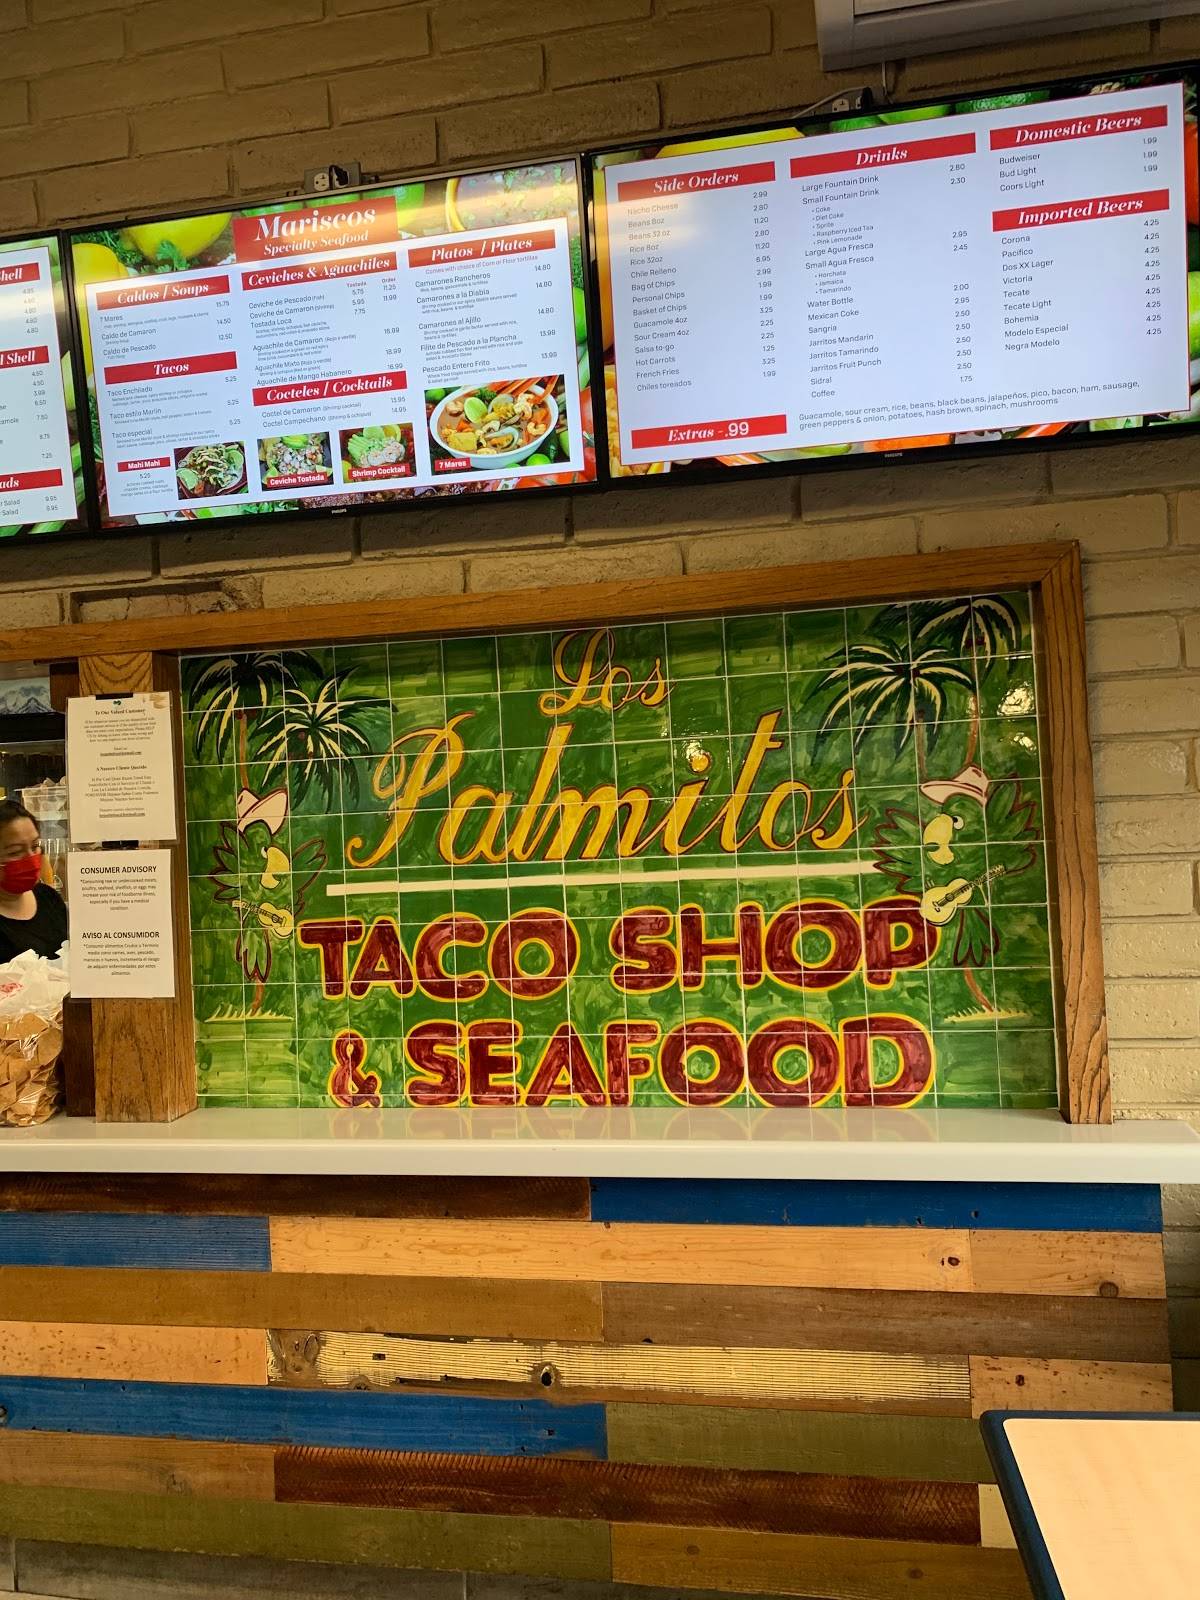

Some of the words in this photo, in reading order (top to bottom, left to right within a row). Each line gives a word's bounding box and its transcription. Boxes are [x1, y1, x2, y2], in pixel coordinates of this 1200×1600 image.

[1015, 120, 1091, 144] Domestic
[1095, 115, 1142, 132] Beers
[855, 147, 908, 166] Drinks
[999, 153, 1041, 165] Budweiser
[999, 168, 1016, 178] Bud
[1017, 166, 1037, 177] Light
[653, 178, 685, 193] Side
[688, 172, 739, 188] Orders
[802, 182, 823, 193] Large
[824, 178, 858, 190] Fountain
[859, 175, 880, 185] Drink
[1000, 181, 1023, 192] Coors
[1025, 179, 1045, 190] Light
[802, 196, 824, 206] Small
[825, 191, 858, 202] Fountain
[859, 188, 880, 198] Drink
[815, 205, 831, 213] Coke
[1018, 202, 1093, 225] Imported
[1096, 199, 1144, 215] Beers
[828, 212, 844, 220] Coke
[254, 208, 377, 241] Mariscos
[816, 228, 848, 238] Raspberry
[1001, 234, 1031, 245] Corona
[263, 238, 318, 257] Specialty
[320, 230, 369, 247] Seafood
[431, 246, 474, 261] Platos
[480, 240, 487, 256] /
[490, 238, 533, 253] Plates
[804, 247, 826, 257] Large
[827, 245, 847, 256] Agua
[848, 242, 874, 252] Fresca
[1002, 248, 1034, 258] Pacifico
[630, 257, 645, 266] Rice
[1002, 262, 1018, 272] Dos
[1019, 261, 1030, 269] XX
[1031, 259, 1054, 269] Lager
[0, 268, 22, 281] hell
[248, 271, 304, 287] Ceviches
[306, 268, 317, 278] &
[319, 257, 390, 278] Aguachiles
[454, 272, 491, 282] Rancheros
[631, 283, 646, 292] Bag
[646, 281, 654, 289] of
[655, 279, 676, 288] Chips
[1003, 275, 1033, 285] Victoria
[117, 290, 160, 304] Caldos
[163, 285, 168, 299] /
[171, 283, 209, 297] Soups
[632, 294, 664, 304] Personal
[665, 291, 685, 300] Chips
[1003, 289, 1030, 298] Tecate
[807, 299, 830, 308] Water
[831, 296, 854, 306] Bottle
[1004, 301, 1031, 311] Tecate
[1032, 299, 1052, 309] Light
[807, 311, 839, 321] Mexican
[840, 309, 860, 318] Coke
[1004, 314, 1039, 325] Bohemia
[633, 318, 674, 329] Guacamole
[808, 324, 837, 335] Sangria
[634, 334, 651, 342] Sour
[652, 331, 676, 340] Cream
[1004, 328, 1034, 338] Modelo
[1035, 323, 1069, 335] Especial
[808, 338, 837, 347] Jarritos
[837, 334, 874, 344] Mandarin
[1005, 341, 1029, 351] Negra
[1030, 338, 1060, 349] Modelo
[634, 345, 654, 354] Salsa
[6, 350, 36, 365] Shell
[635, 359, 649, 367] Hot
[649, 356, 676, 365] Carrots
[153, 363, 190, 376] Tacos
[810, 363, 838, 373] Jarritos
[839, 360, 856, 369] Fruit
[857, 358, 882, 367] Punch
[636, 370, 661, 379] French
[662, 367, 680, 376] Fries
[636, 382, 659, 392] Chiles
[810, 376, 832, 386] Sidral
[266, 387, 320, 401] Cocteles
[323, 380, 330, 397] /
[332, 376, 393, 394] Cocktails
[811, 389, 835, 398] Coffee
[799, 421, 822, 431] green
[823, 418, 855, 429] peppers
[855, 416, 862, 424] &
[925, 408, 945, 417] hash
[1010, 397, 1059, 408] mushrooms
[667, 429, 714, 442] Extras
[144, 460, 160, 468] Mahi
[439, 460, 444, 469] 7
[444, 458, 467, 468] Mares
[352, 468, 377, 478] Shrimp
[377, 465, 406, 475] Cocktail
[270, 476, 297, 486] Ceviche
[297, 473, 325, 483] Tostada
[538, 628, 675, 718] Los
[345, 709, 870, 868] Palmitos
[121, 865, 157, 873] ADVISORY
[112, 931, 160, 939] CONSUMIDOR
[299, 906, 580, 1002] TACO
[610, 898, 941, 994] SHOP
[328, 1029, 383, 1108] &
[404, 1013, 935, 1109] SEAFOOD
